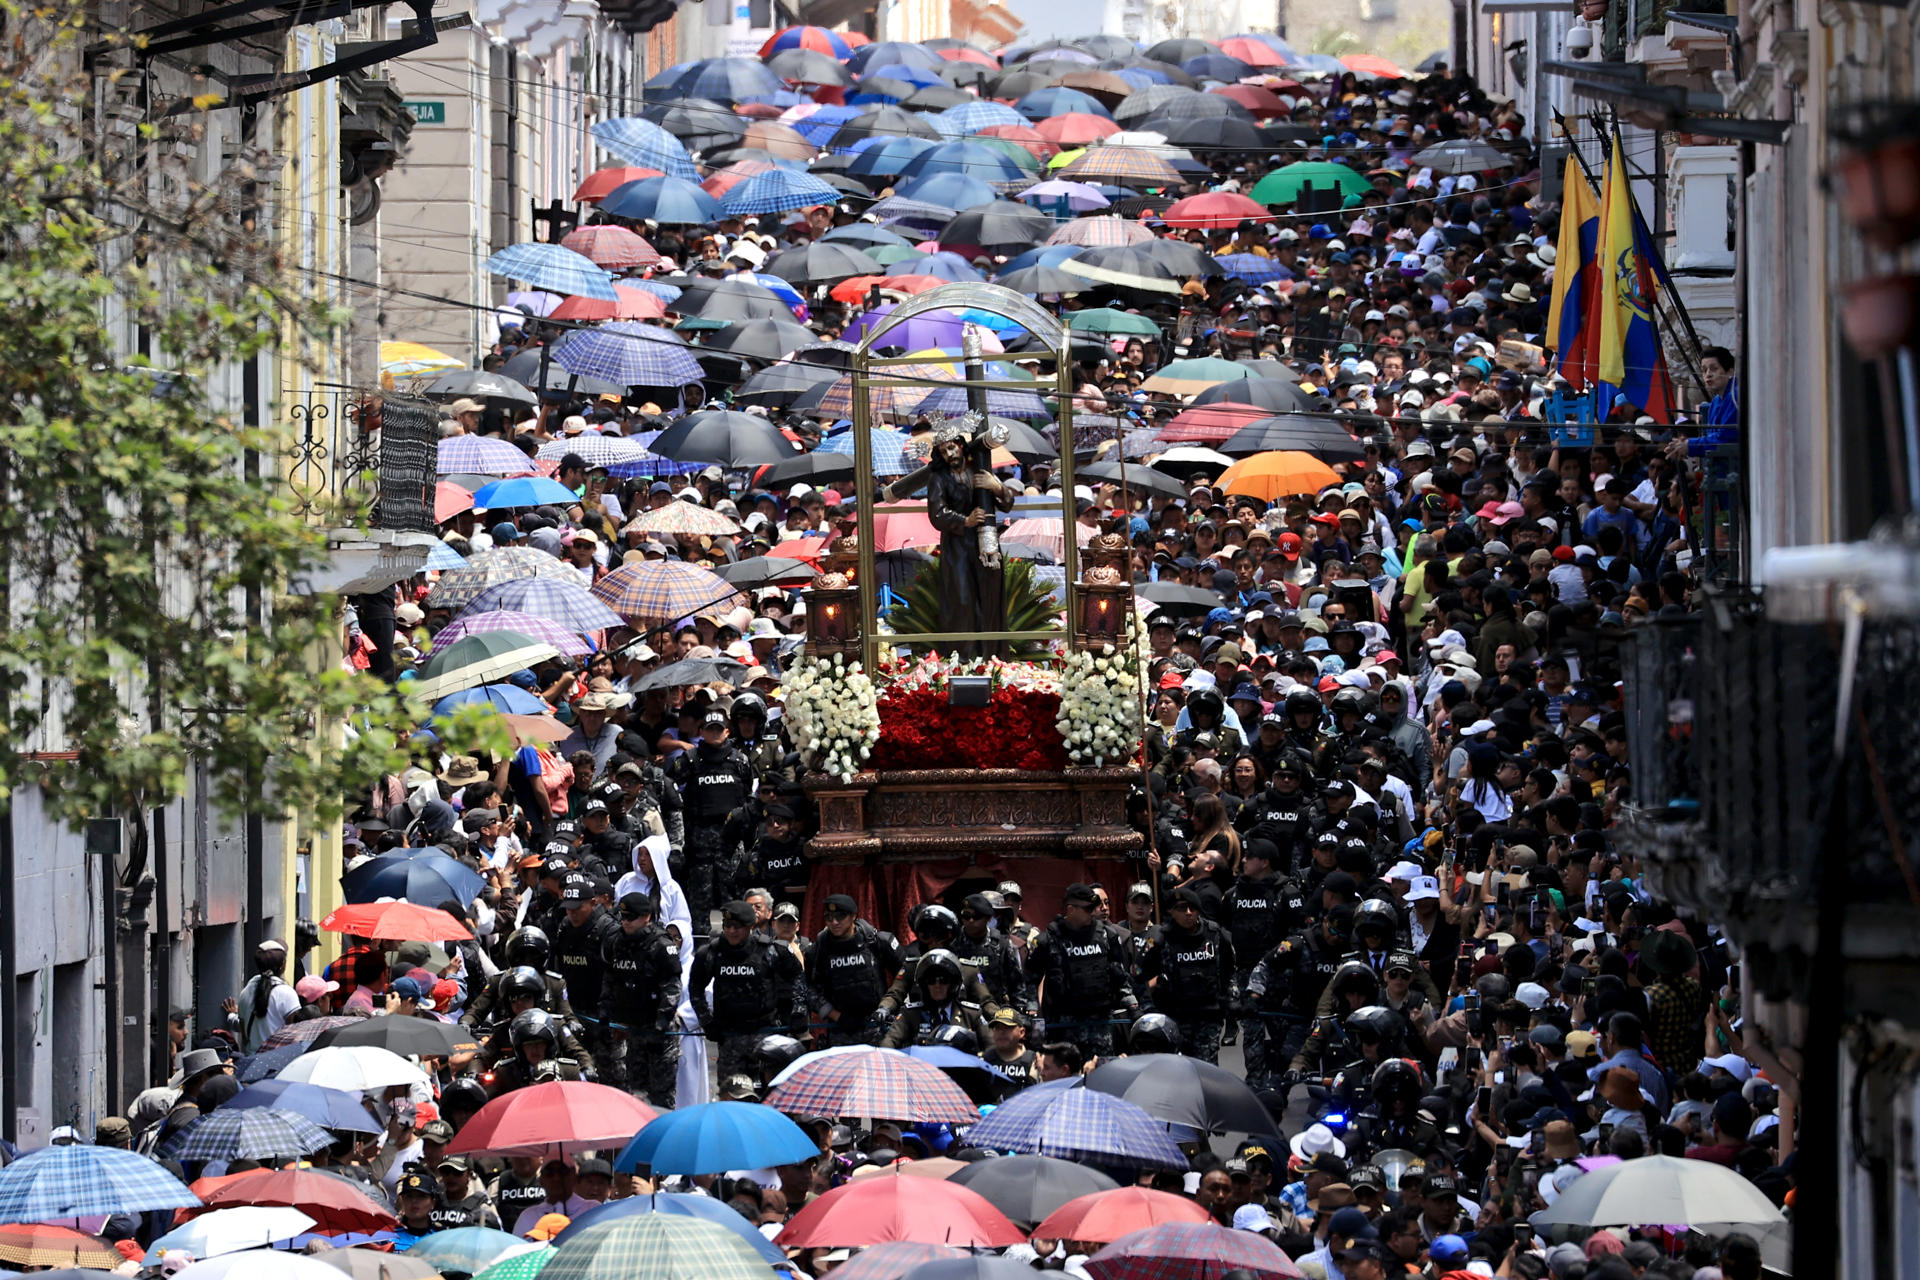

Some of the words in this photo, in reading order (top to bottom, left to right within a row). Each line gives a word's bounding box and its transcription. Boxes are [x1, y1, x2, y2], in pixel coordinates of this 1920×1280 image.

[698, 774, 735, 785] POLICIA
[1237, 899, 1267, 910] POLICIA
[563, 955, 588, 966] POLICIA
[830, 954, 866, 969] POLICIA
[720, 966, 756, 976] POLICIA
[502, 1187, 547, 1200] POLICIA
